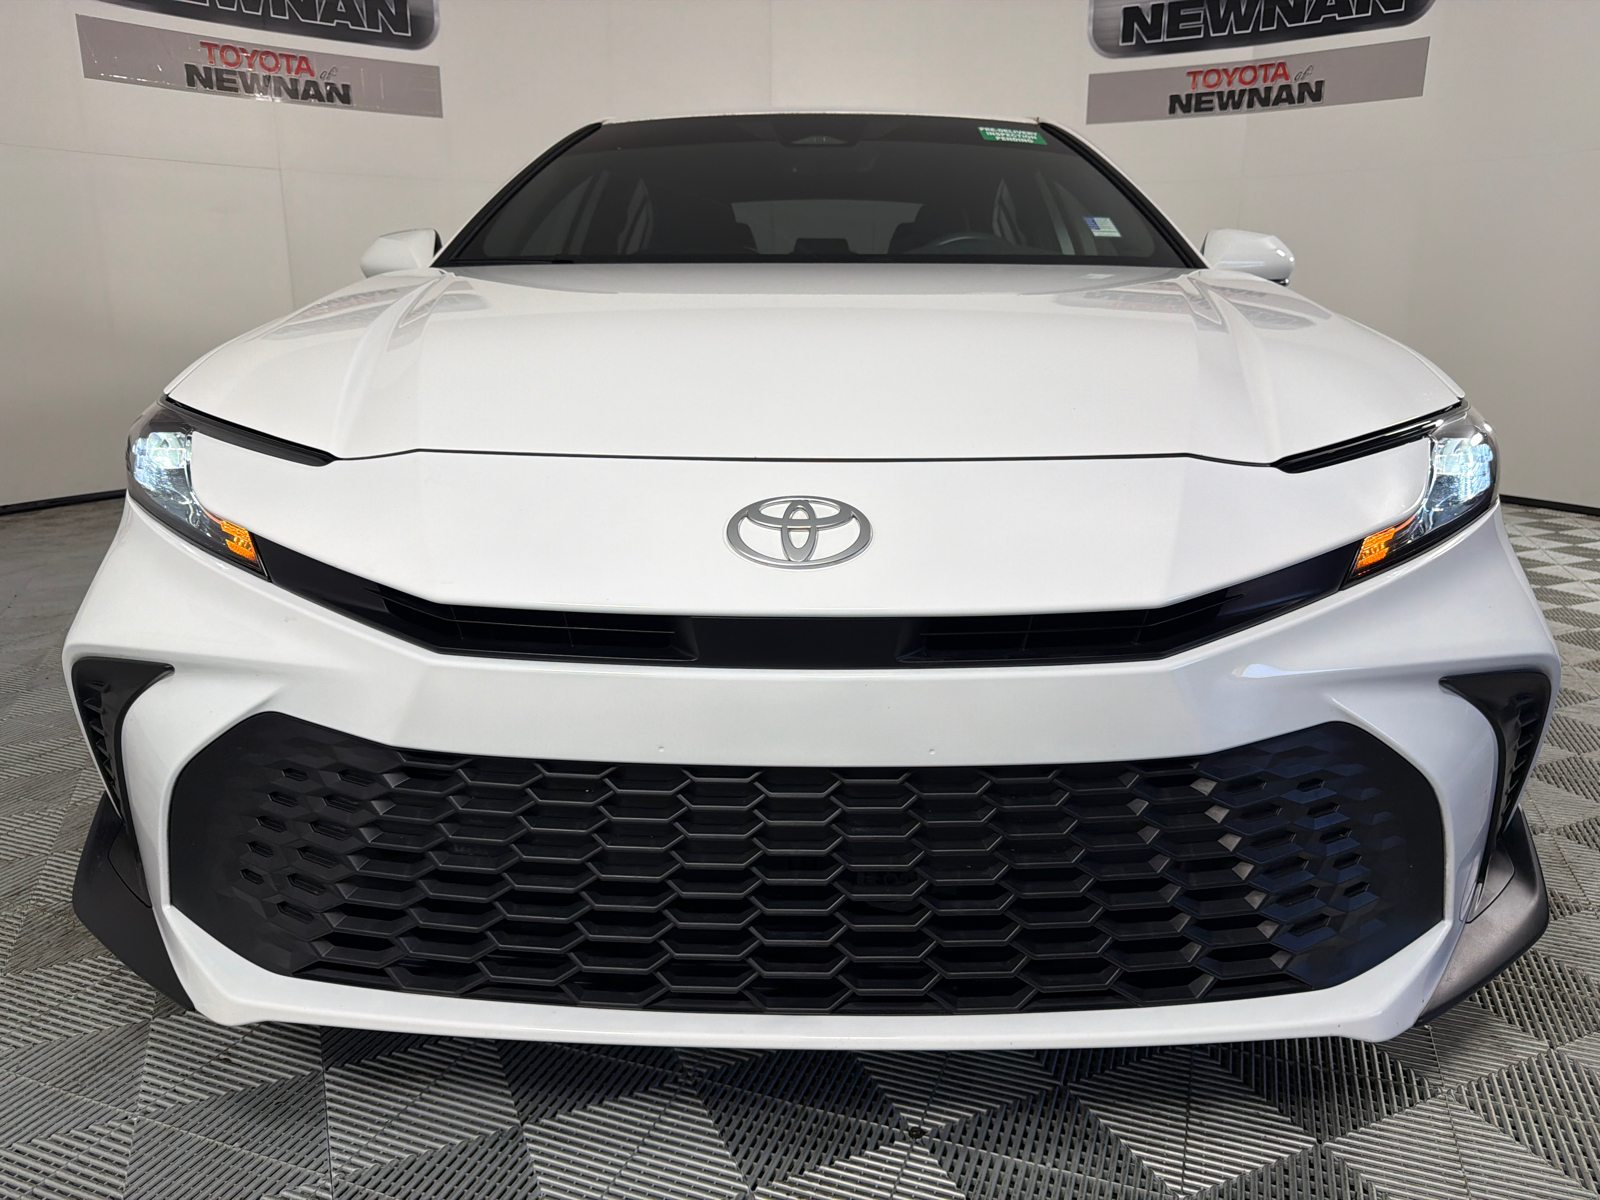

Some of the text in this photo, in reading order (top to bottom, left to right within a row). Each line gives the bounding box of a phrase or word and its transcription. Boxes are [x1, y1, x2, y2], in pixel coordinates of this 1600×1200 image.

[200, 41, 338, 80] TOYOTA of
[1186, 62, 1313, 90] TOYOTA of
[184, 63, 351, 105] NEWNAN
[1168, 80, 1324, 115] NEWNAN
[986, 131, 1037, 140] INSPECTION
